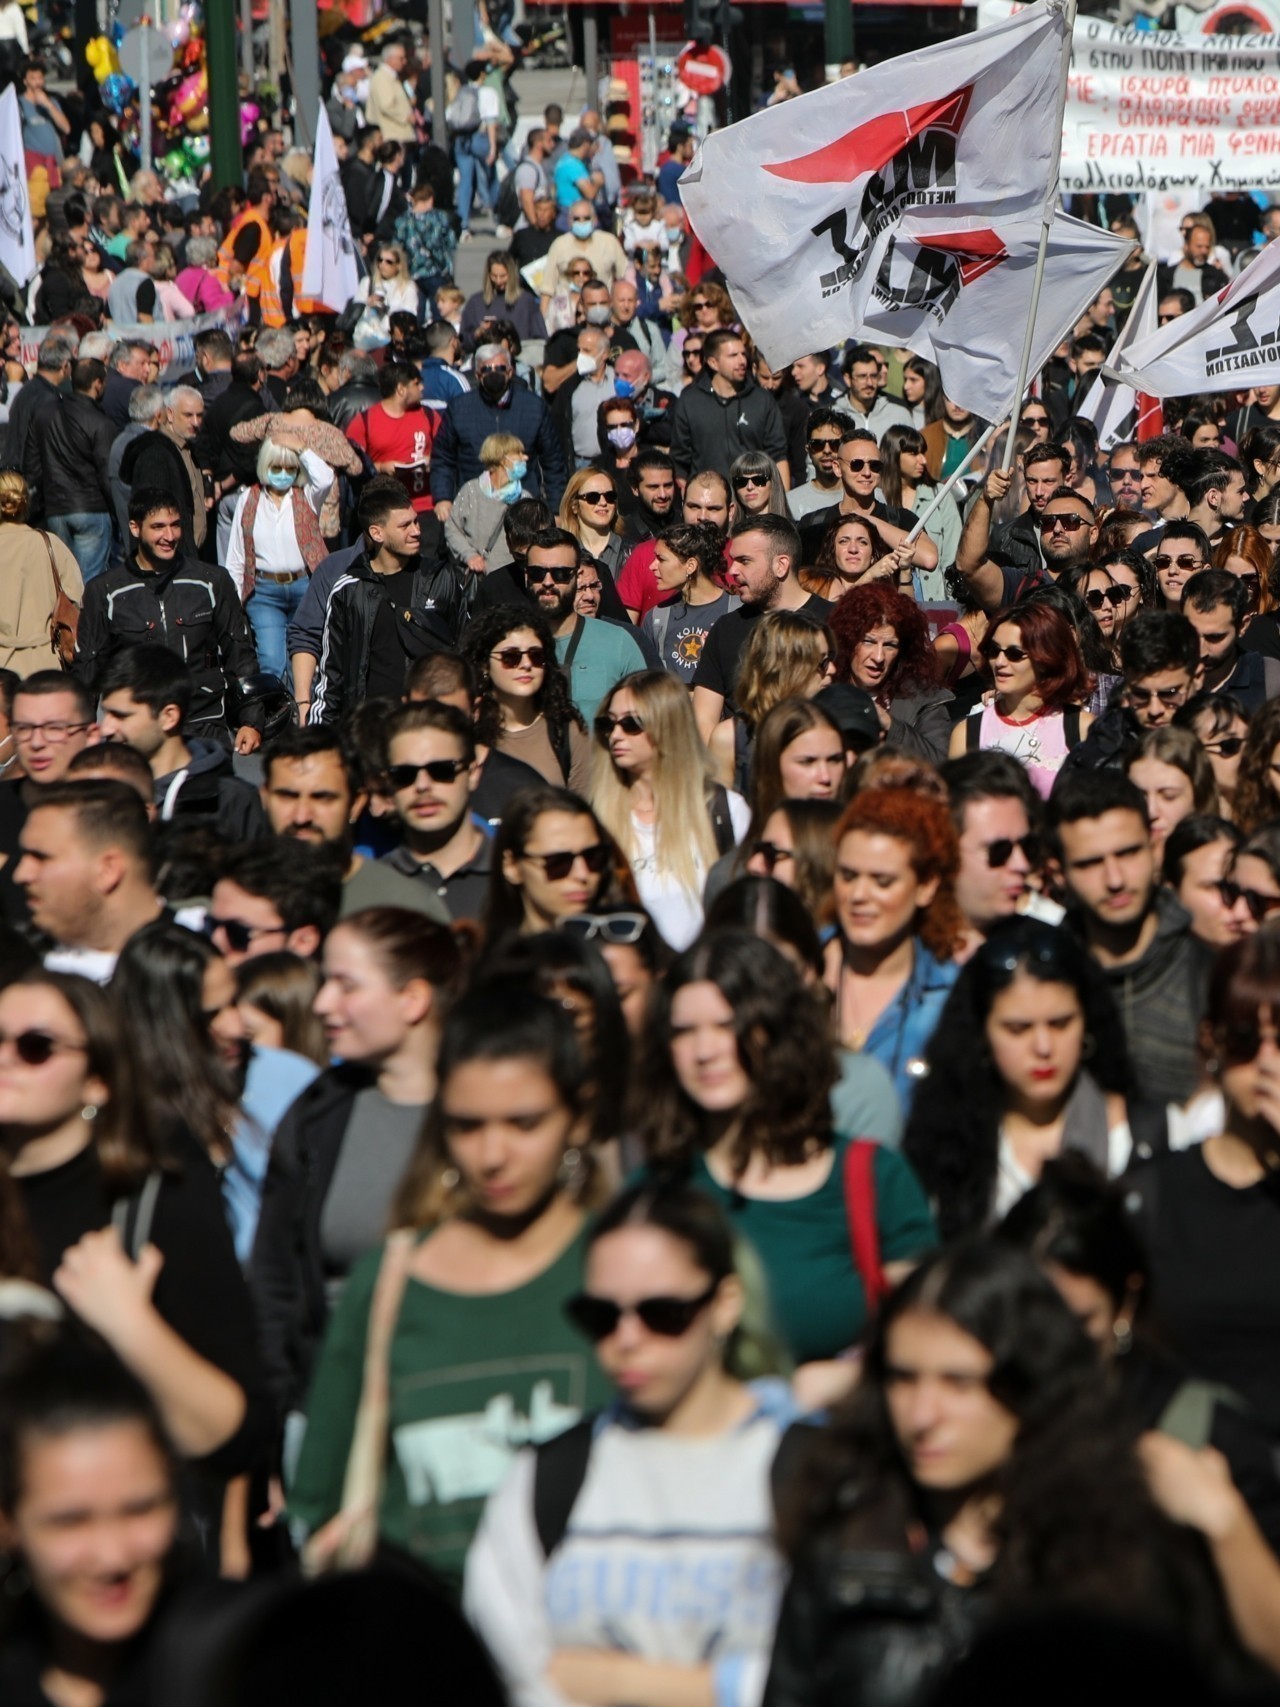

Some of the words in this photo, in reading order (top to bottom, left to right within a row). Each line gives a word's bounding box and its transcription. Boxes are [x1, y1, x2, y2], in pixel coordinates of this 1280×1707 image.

[1088, 133, 1168, 157] ΕΡΓΑΤΙΑ
[1180, 132, 1216, 156] ΜΙΑ
[671, 651, 698, 669] ΘΝΗΤ
